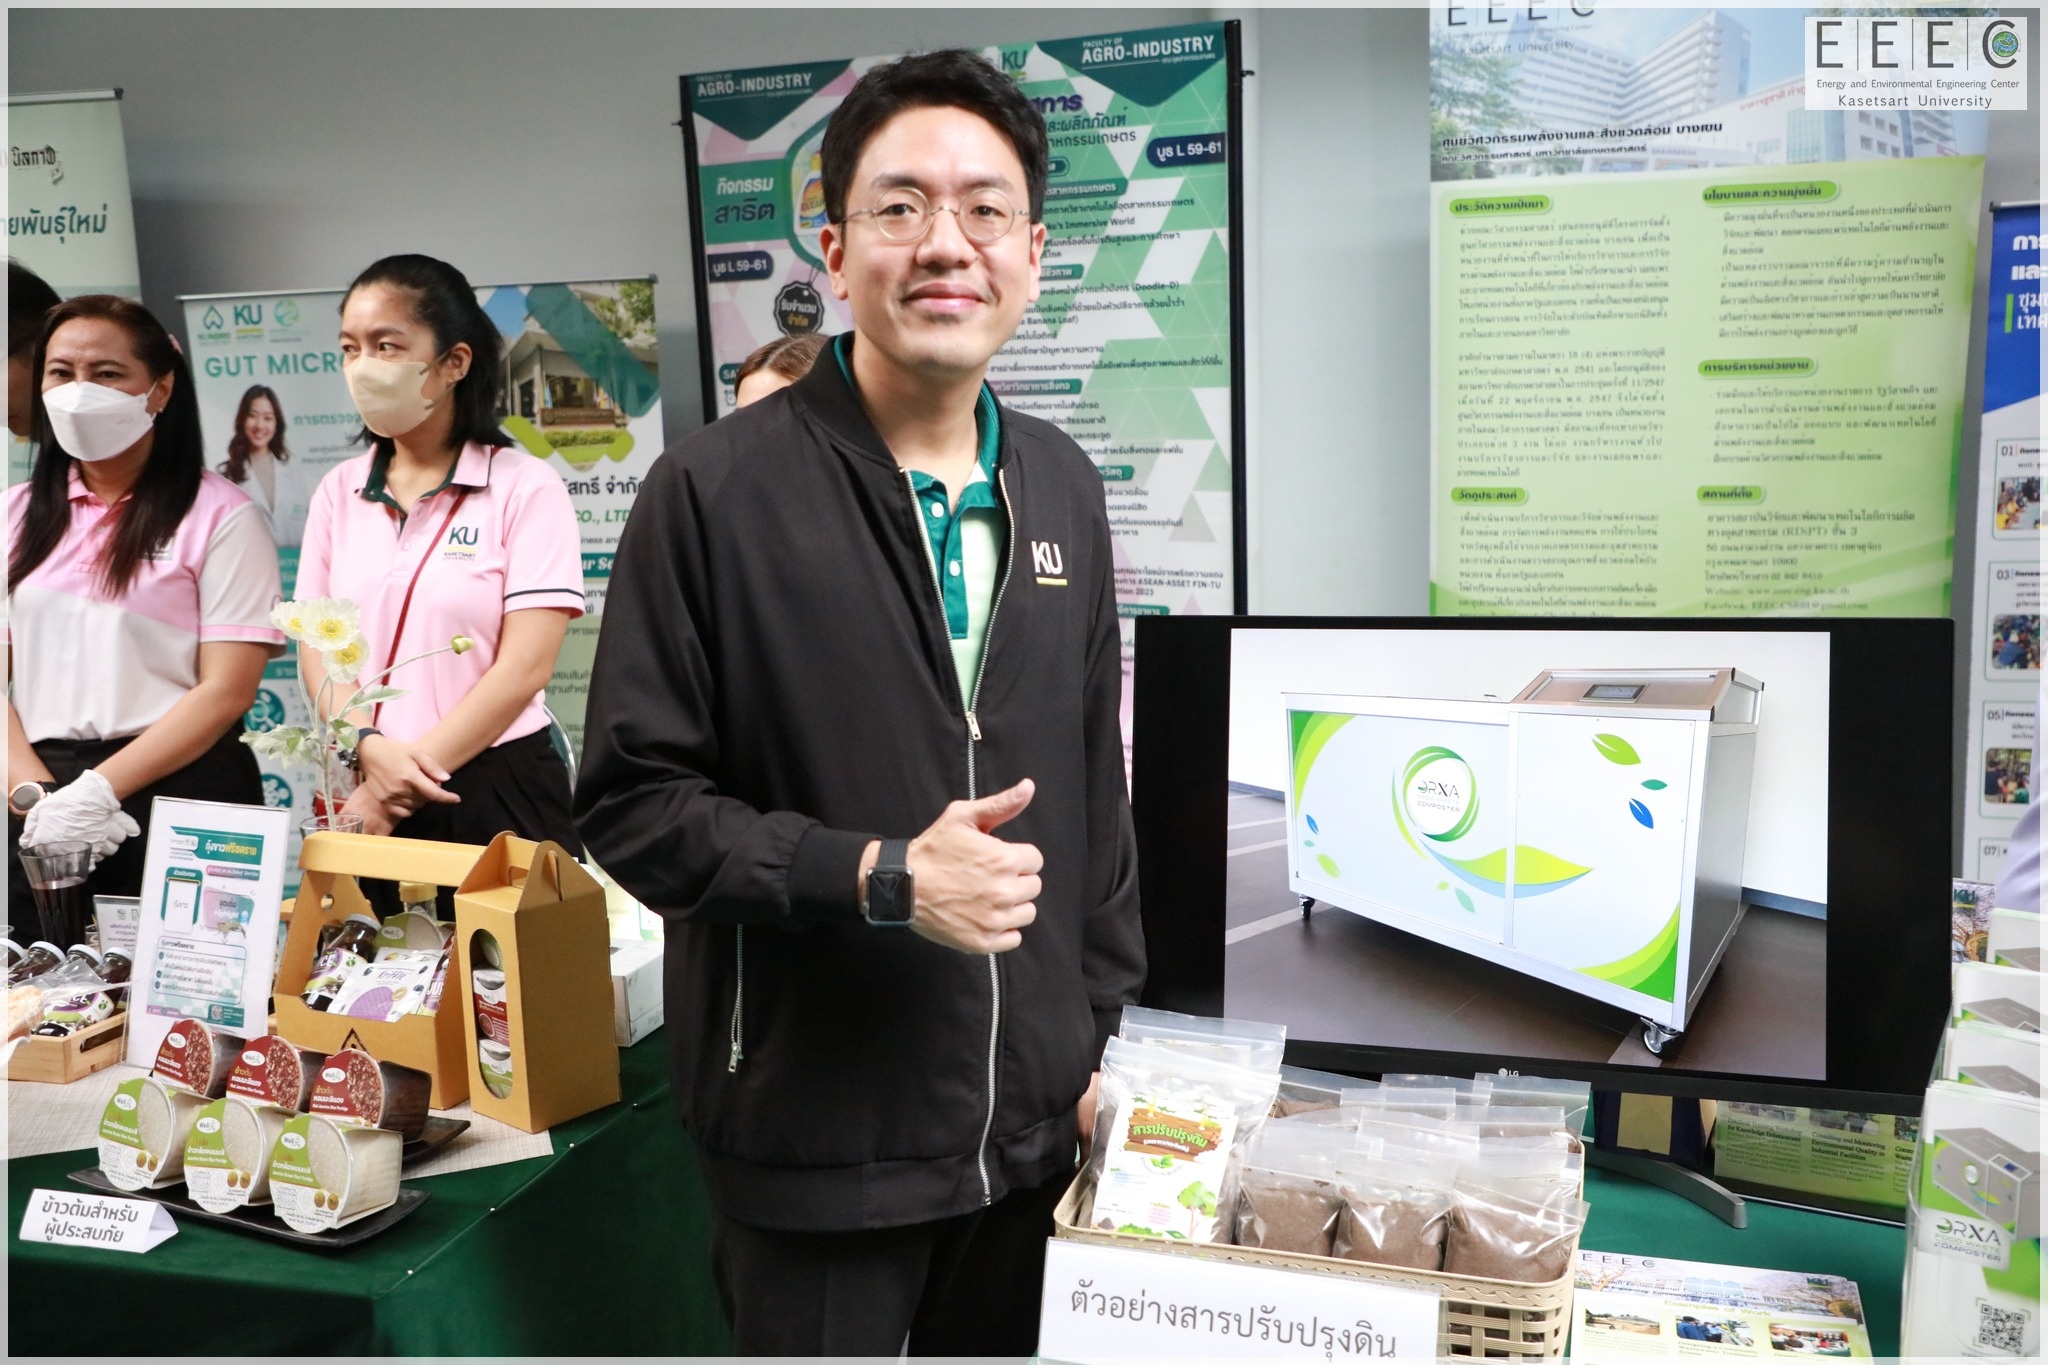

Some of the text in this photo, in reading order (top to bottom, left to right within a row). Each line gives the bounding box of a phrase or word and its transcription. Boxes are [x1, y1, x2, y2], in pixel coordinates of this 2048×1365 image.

[1081, 35, 1215, 65] AGRO-INDUSTRY
[1518, 40, 1576, 52] University
[1001, 49, 1027, 71] KU
[697, 73, 813, 97] AGRO-INDUSTRY
[1156, 141, 1222, 162] บูธ L 59-61
[716, 177, 775, 196] กิจกรรม
[714, 197, 776, 225] สาธิต
[1065, 216, 1136, 230] Immersive World
[712, 258, 768, 277] บูธ L 59-61
[233, 303, 264, 326] KU
[1027, 317, 1057, 326] Banana
[204, 351, 344, 378] GUT MICR
[2000, 445, 2014, 457] 01
[448, 526, 479, 546] KU
[1031, 540, 1063, 575] KU
[1138, 579, 1191, 588] ASEAN-ASSET
[1996, 569, 2010, 581] 03
[1135, 588, 1155, 597] 2023
[1987, 709, 2001, 721] 05
[1417, 800, 1461, 813] COMPOSTER
[1983, 844, 1997, 857] 07
[1132, 1123, 1209, 1149] สารปรับปรุงดิน
[1736, 1125, 1766, 1137] Knowledge
[1811, 1139, 1854, 1152] Environmental
[1855, 1147, 1878, 1157] Quality
[1854, 1138, 1886, 1151] Monitoring
[1811, 1146, 1867, 1162] Industrial Facilities
[272, 1160, 311, 1175] ข้าวกล้องหอมมะลิ
[42, 1195, 140, 1223] ข้าวต้มสำหรับ
[44, 1216, 125, 1243] ผู้ประสบภัย
[1934, 1233, 1963, 1245] FOOD
[1933, 1241, 2002, 1262] COMPOSTER
[1663, 1299, 1720, 1312] Examples
[1739, 1308, 1772, 1317] Work
[1070, 1278, 1398, 1363] ตัวอย่างสารปรับปรุงดิน
